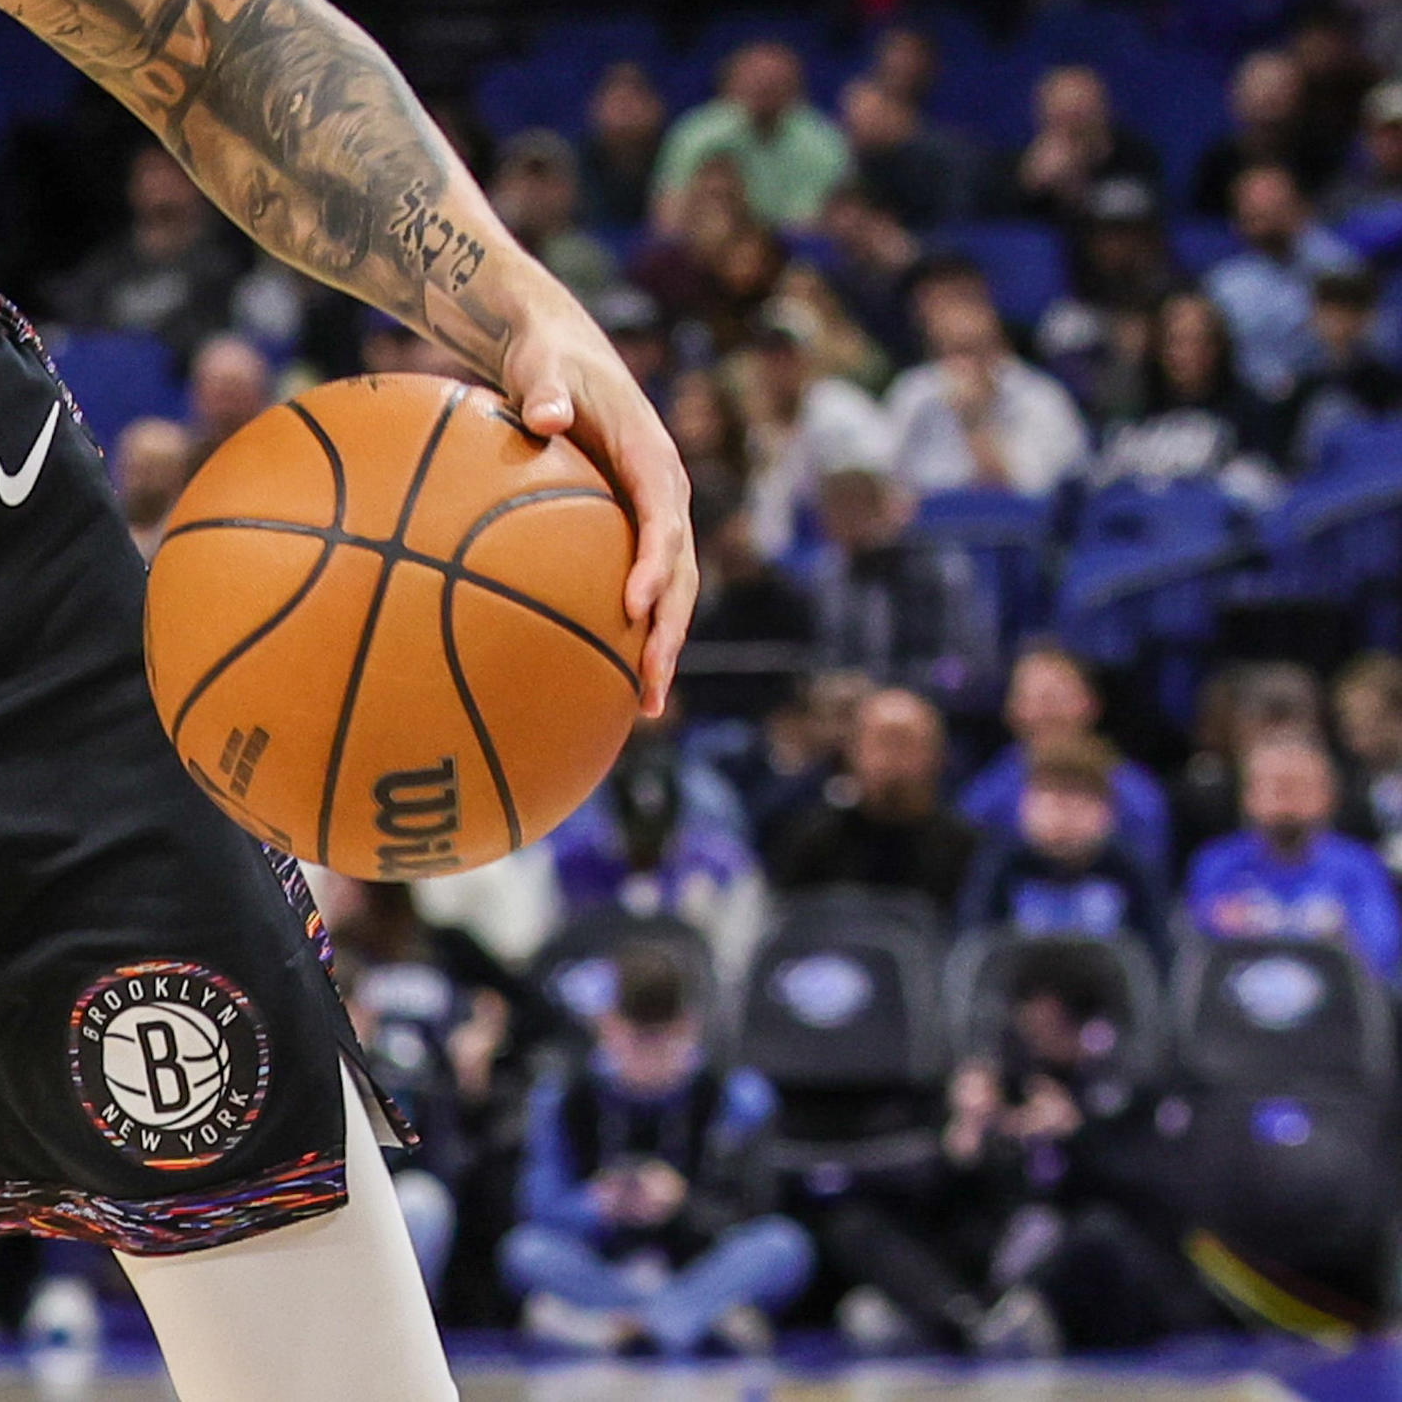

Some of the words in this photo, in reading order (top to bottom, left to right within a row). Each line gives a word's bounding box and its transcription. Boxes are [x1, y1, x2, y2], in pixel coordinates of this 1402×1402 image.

[82, 976, 239, 1042] BROOKLYN
[135, 1020, 190, 1114] B
[101, 1102, 163, 1153] NEW
[179, 1088, 250, 1153] YORK
